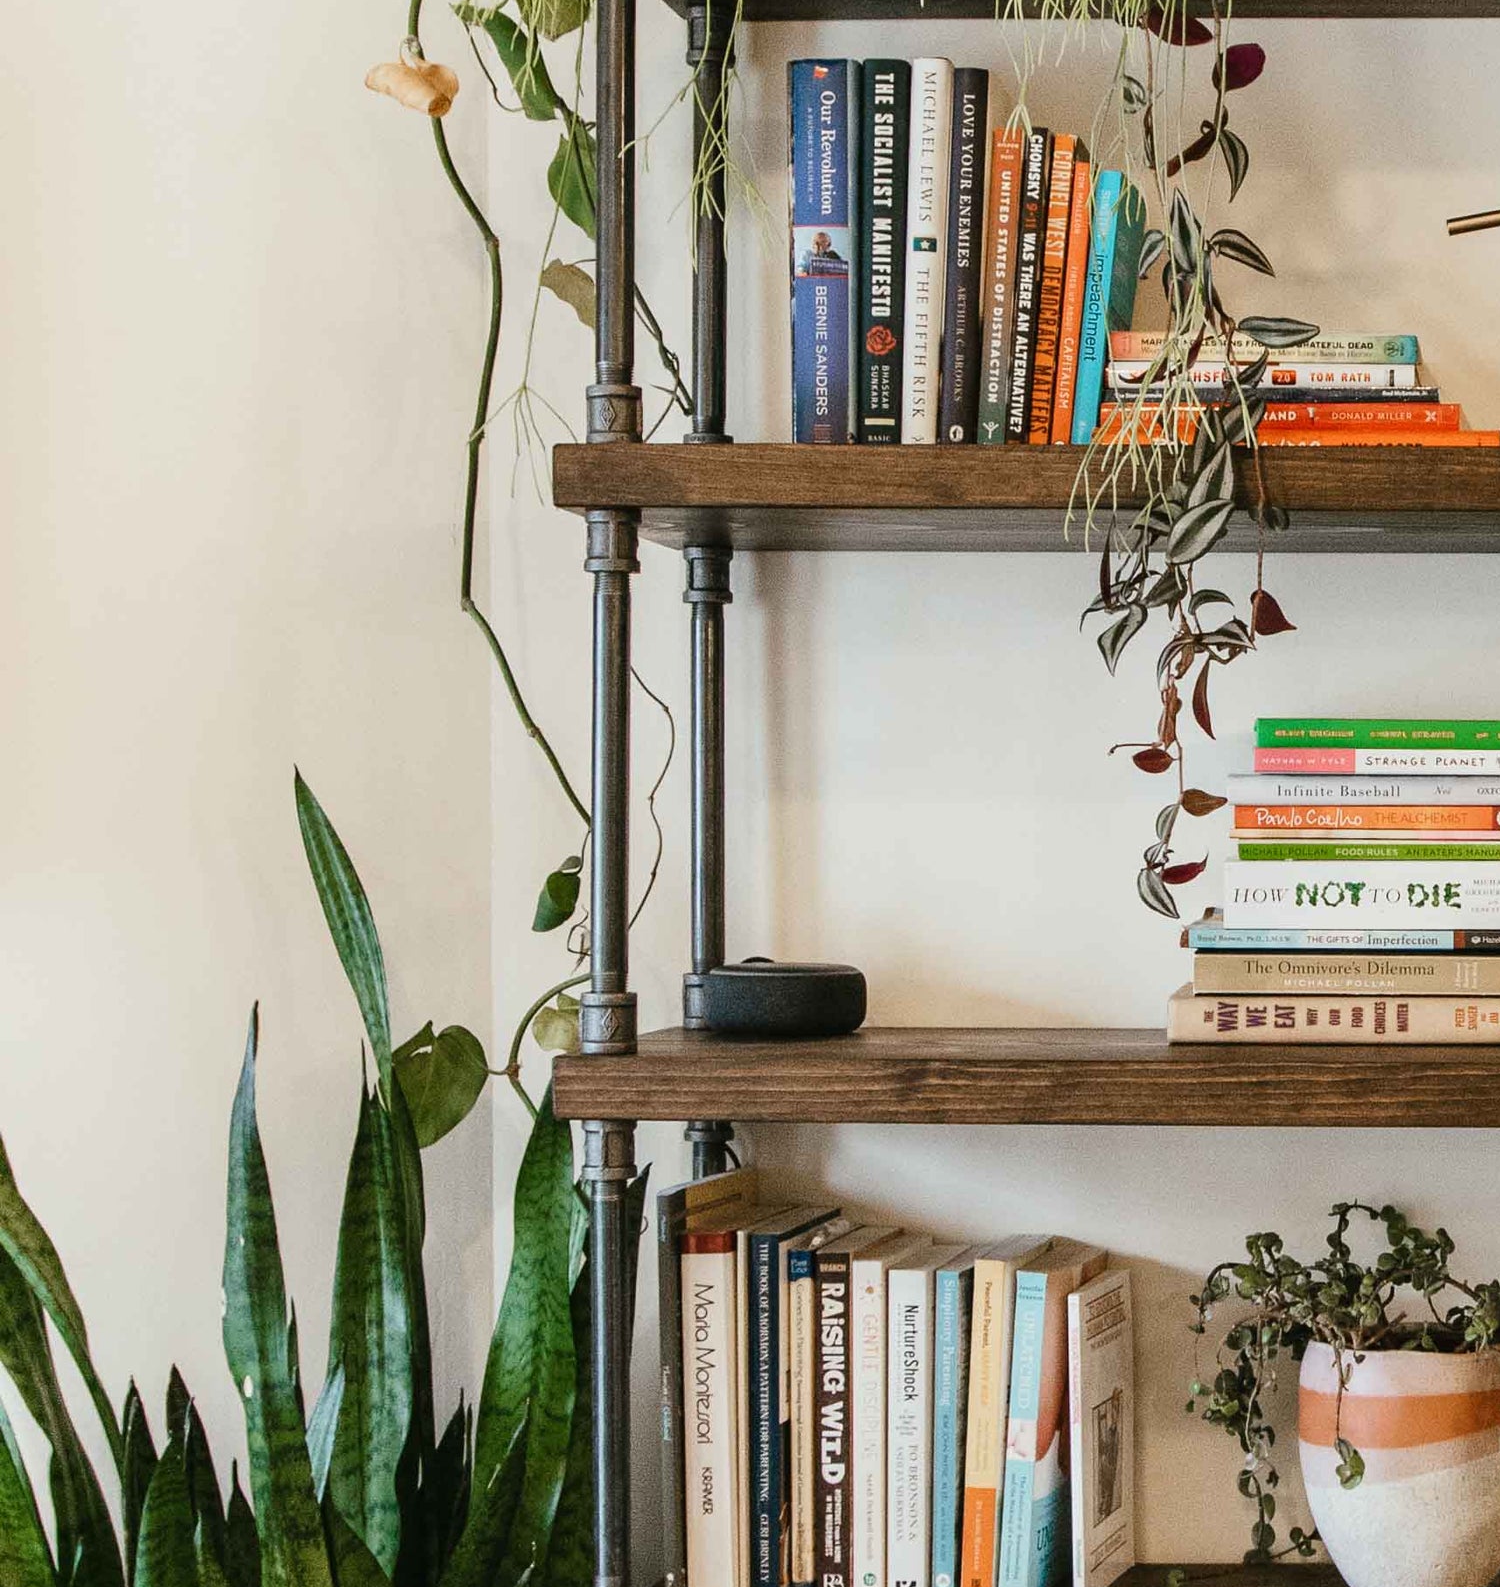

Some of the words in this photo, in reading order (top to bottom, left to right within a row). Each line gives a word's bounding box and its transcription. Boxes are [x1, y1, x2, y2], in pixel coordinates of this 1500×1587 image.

[820, 91, 836, 124] Our
[874, 73, 894, 105] THE
[921, 71, 937, 157] MICHAEL
[963, 94, 976, 137] LOVE
[821, 128, 837, 215] Revolution
[873, 111, 894, 208] SOCIALIST
[960, 141, 974, 189] YOUR
[1026, 134, 1044, 200] CHOMSKY
[1050, 150, 1073, 208] CORNEL
[919, 166, 934, 222] LEWIS
[998, 171, 1012, 223] UNITED
[956, 196, 973, 269] ENEMIES
[995, 229, 1009, 279] STATES
[1022, 233, 1037, 261] WAS
[1045, 217, 1068, 259] WEST
[871, 218, 892, 318] MANIFESTO
[915, 269, 930, 305] THE
[1018, 266, 1035, 309] THERE
[815, 286, 828, 340] BERNIE
[994, 284, 1006, 302] OF
[1036, 264, 1062, 356] DEMOCRACY
[1083, 253, 1106, 362] impeachment
[914, 314, 929, 369] FIFTH
[1017, 313, 1031, 332] AN
[987, 308, 1004, 403] DISTRACTION
[1348, 341, 1374, 350] DEAD
[815, 345, 830, 416] SANDERS
[870, 366, 879, 411] SUNKARA
[881, 366, 890, 411] BHASKAR
[1009, 336, 1029, 434] ALTERNATIVE?
[1058, 336, 1075, 410] CAPITALISM
[1310, 372, 1335, 383] TOM
[1341, 372, 1371, 383] RATH
[912, 376, 927, 419] RISK
[1029, 364, 1054, 434] MATTERS
[1332, 412, 1374, 421] DONALD
[1377, 412, 1412, 421] MILLER
[1365, 756, 1426, 766] STRANGE
[1436, 757, 1486, 767] PLANET
[1277, 784, 1334, 797] Infinite
[1340, 785, 1400, 797] Baseball
[1255, 807, 1302, 827] Paulo
[1306, 807, 1362, 828] Coelho
[1375, 812, 1398, 824] THE
[1400, 813, 1468, 824] ALCHEMIST
[1241, 847, 1283, 856] MICHAEL
[1288, 847, 1328, 856] POLLAN
[1335, 847, 1364, 856] FOOD
[1367, 847, 1398, 856] RULES
[1406, 848, 1421, 857] AN
[1234, 887, 1289, 903] HOW
[1295, 880, 1366, 907] NOT
[1369, 888, 1401, 904] TO
[1407, 882, 1462, 909] DIE
[1307, 935, 1324, 944] THE
[1327, 935, 1350, 944] GIFTS
[1352, 935, 1364, 944] OF
[1367, 934, 1438, 947] Imperfection
[1244, 960, 1273, 974] The
[1278, 960, 1361, 975] Omnivore's
[1368, 961, 1434, 975] Dilemma
[1284, 979, 1339, 988] MICHAEL
[1346, 979, 1395, 988] POLLAN
[1217, 1001, 1239, 1032] WAY
[1246, 1006, 1268, 1028] WE
[1274, 1004, 1296, 1029] EAT
[1306, 1008, 1319, 1026] WHY
[1351, 1006, 1364, 1028] FOOD
[1373, 1001, 1386, 1035] CHOICES
[759, 1265, 770, 1294] BOOK
[694, 1284, 714, 1342] Maria
[759, 1296, 770, 1310] OF
[759, 1311, 770, 1360] MORMON
[903, 1304, 920, 1402] NurtureShock
[695, 1347, 716, 1445] Montessori
[759, 1372, 770, 1419] PATTERN
[940, 1345, 954, 1406] Parenting
[759, 1421, 770, 1442] FOR
[819, 1401, 846, 1485] WILD
[702, 1466, 714, 1516] KRAMER
[759, 1444, 770, 1502] PARENTING
